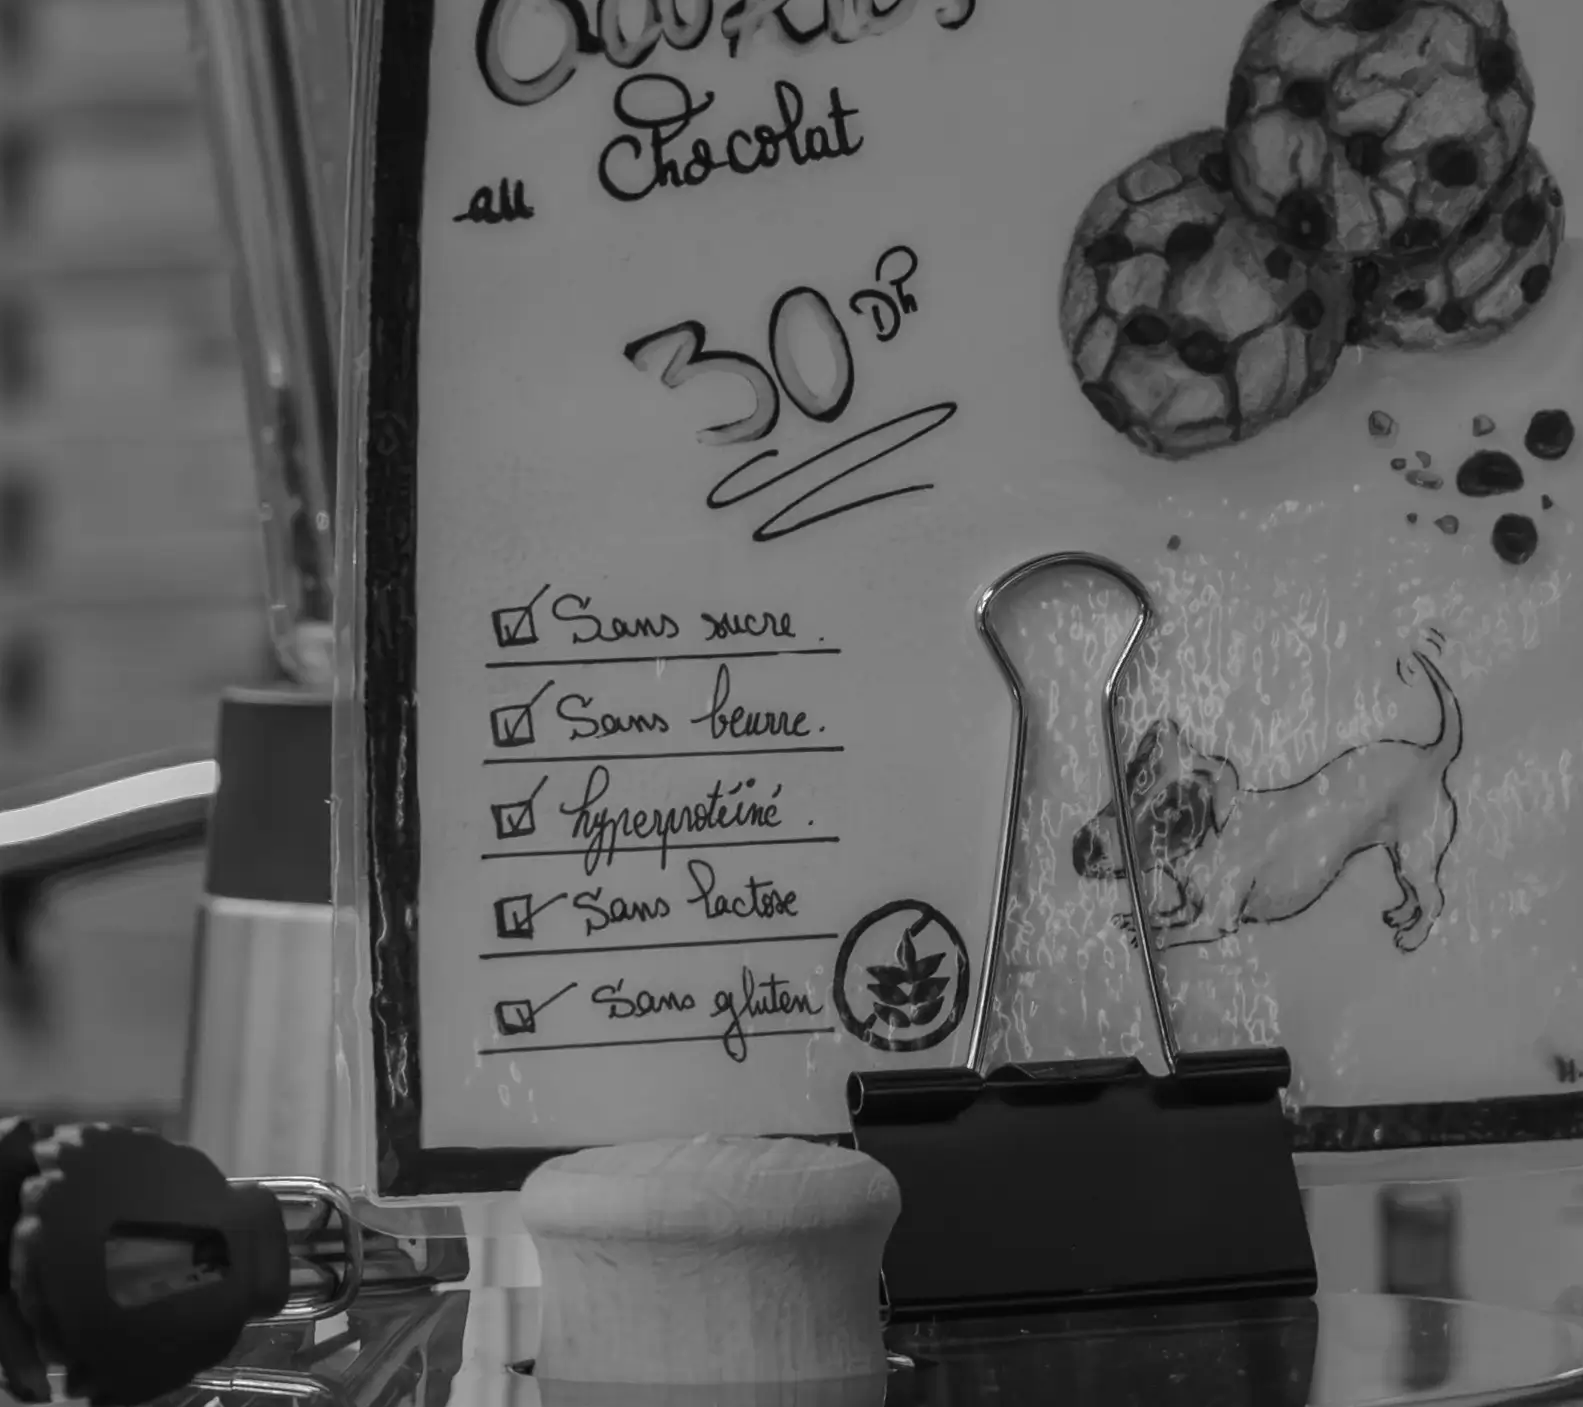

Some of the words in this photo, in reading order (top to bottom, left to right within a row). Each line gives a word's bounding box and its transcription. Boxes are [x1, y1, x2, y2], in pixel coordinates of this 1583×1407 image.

[452, 178, 535, 225] au
[597, 72, 865, 202] Chocolat
[623, 285, 856, 446] 30
[551, 592, 680, 644] Sans
[555, 692, 670, 741] Sans
[571, 886, 671, 937] Sans
[686, 858, 799, 920] lactose
[590, 978, 696, 1019] Sans
[709, 965, 824, 1063] gluten
